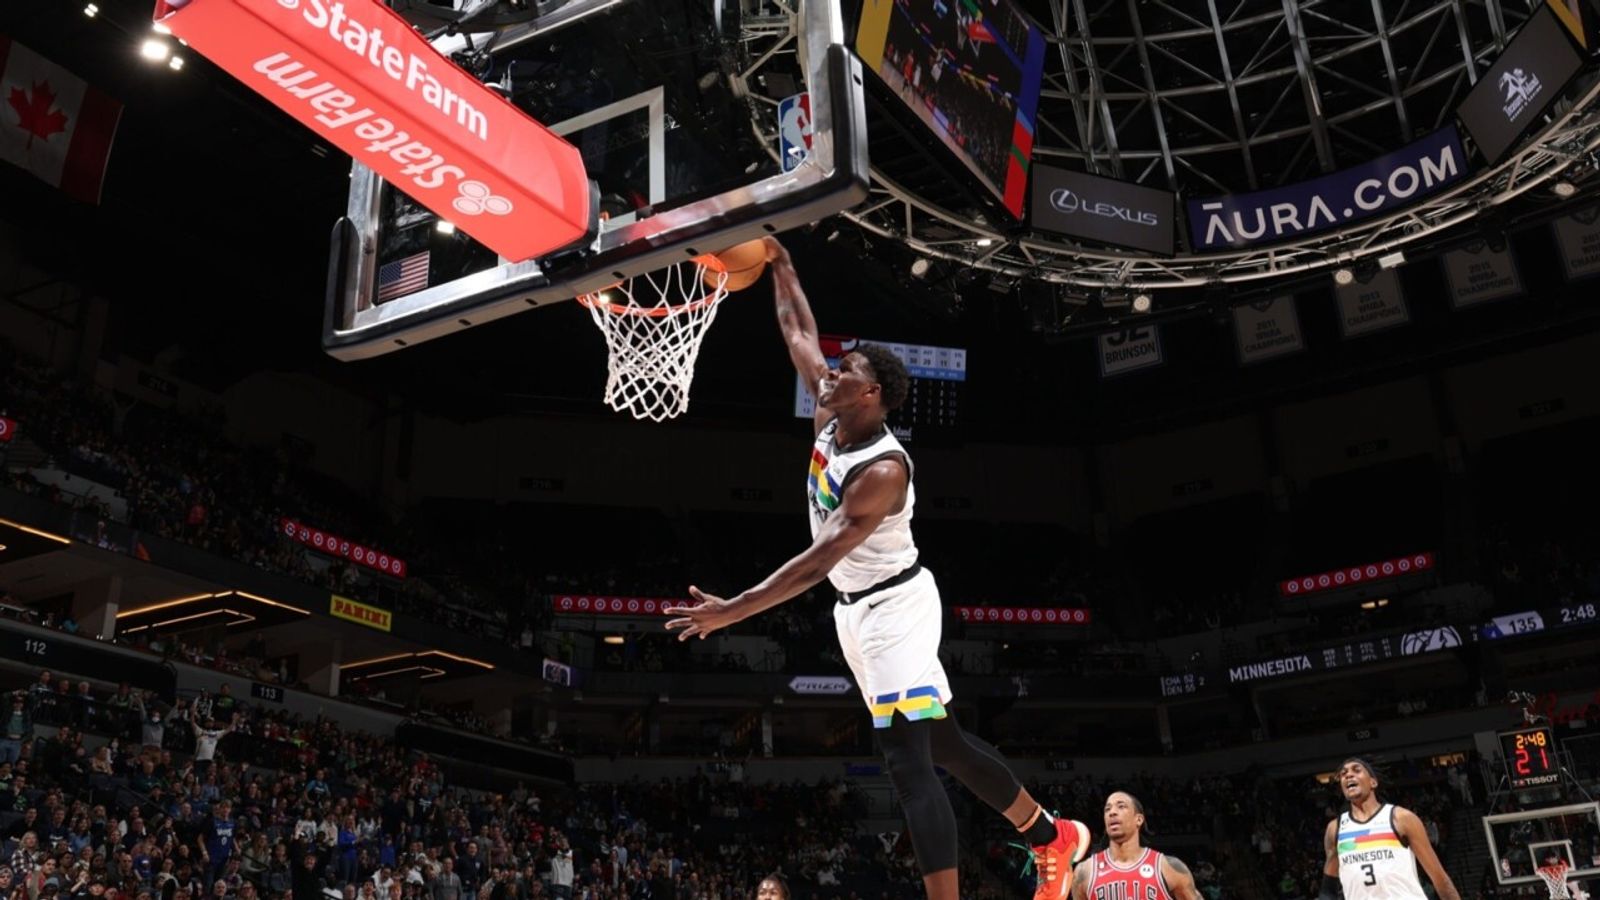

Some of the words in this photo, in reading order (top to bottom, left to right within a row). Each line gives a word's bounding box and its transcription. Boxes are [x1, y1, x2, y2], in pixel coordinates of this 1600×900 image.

[1081, 200, 1158, 227] LEXUS
[1105, 341, 1156, 364] BRUNSON
[334, 599, 389, 627] PANINI
[1561, 604, 1596, 623] 2:48
[1509, 617, 1537, 634] 135
[24, 639, 47, 655] 112
[1229, 655, 1312, 682] MINNESOTA
[260, 685, 277, 699] 113
[1515, 731, 1547, 750] 2:48
[1526, 774, 1559, 787] TISSOT
[1342, 850, 1395, 866] MINNESOTA
[1360, 863, 1377, 887] 3
